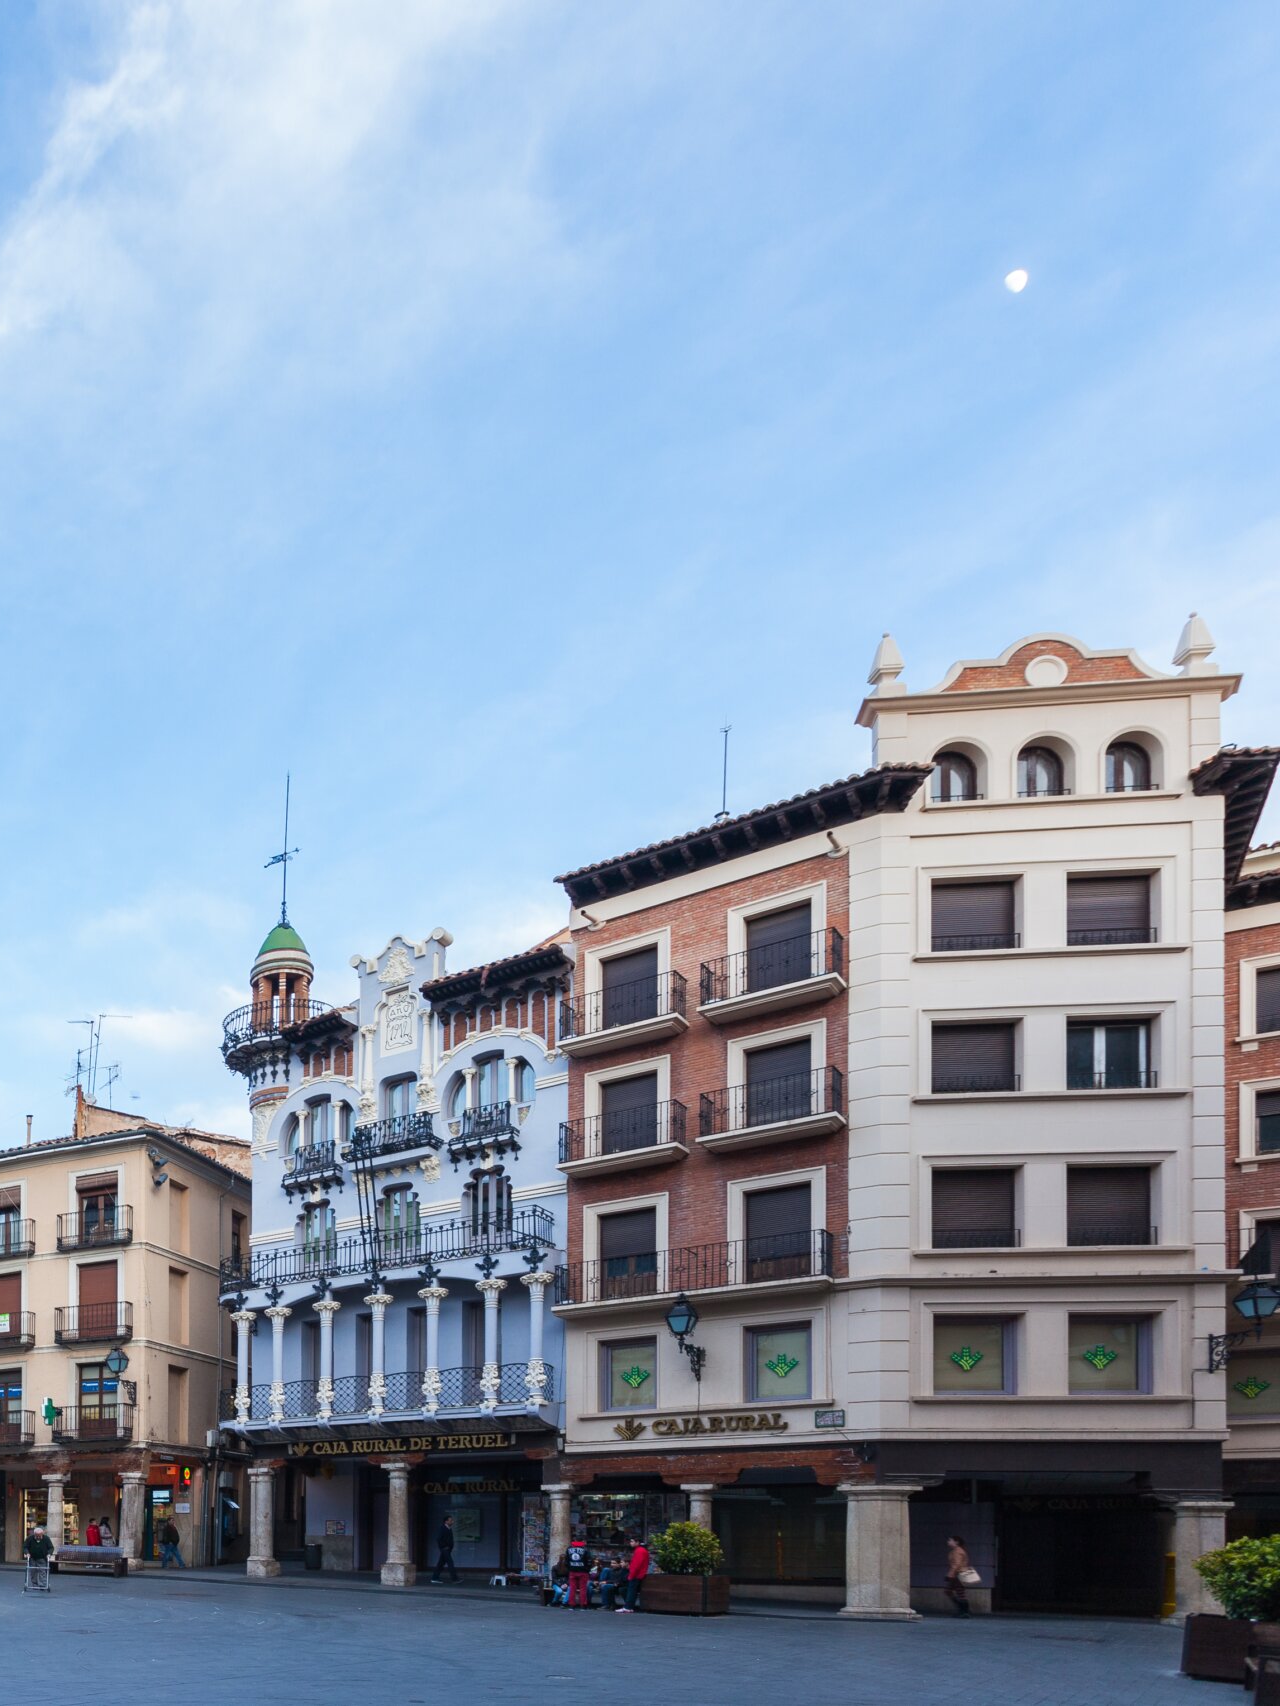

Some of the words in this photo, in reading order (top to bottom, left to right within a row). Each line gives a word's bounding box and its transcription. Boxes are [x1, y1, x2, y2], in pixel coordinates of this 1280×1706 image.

[652, 1417, 706, 1435] CAJA
[707, 1412, 789, 1432] RURAL
[312, 1442, 349, 1455] CAJA
[352, 1439, 406, 1453] RURAL
[409, 1437, 431, 1450] DE
[437, 1434, 508, 1449] TERUEL
[423, 1482, 459, 1495] CAJA
[465, 1480, 520, 1493] RURAL
[1047, 1498, 1089, 1510] CAJA
